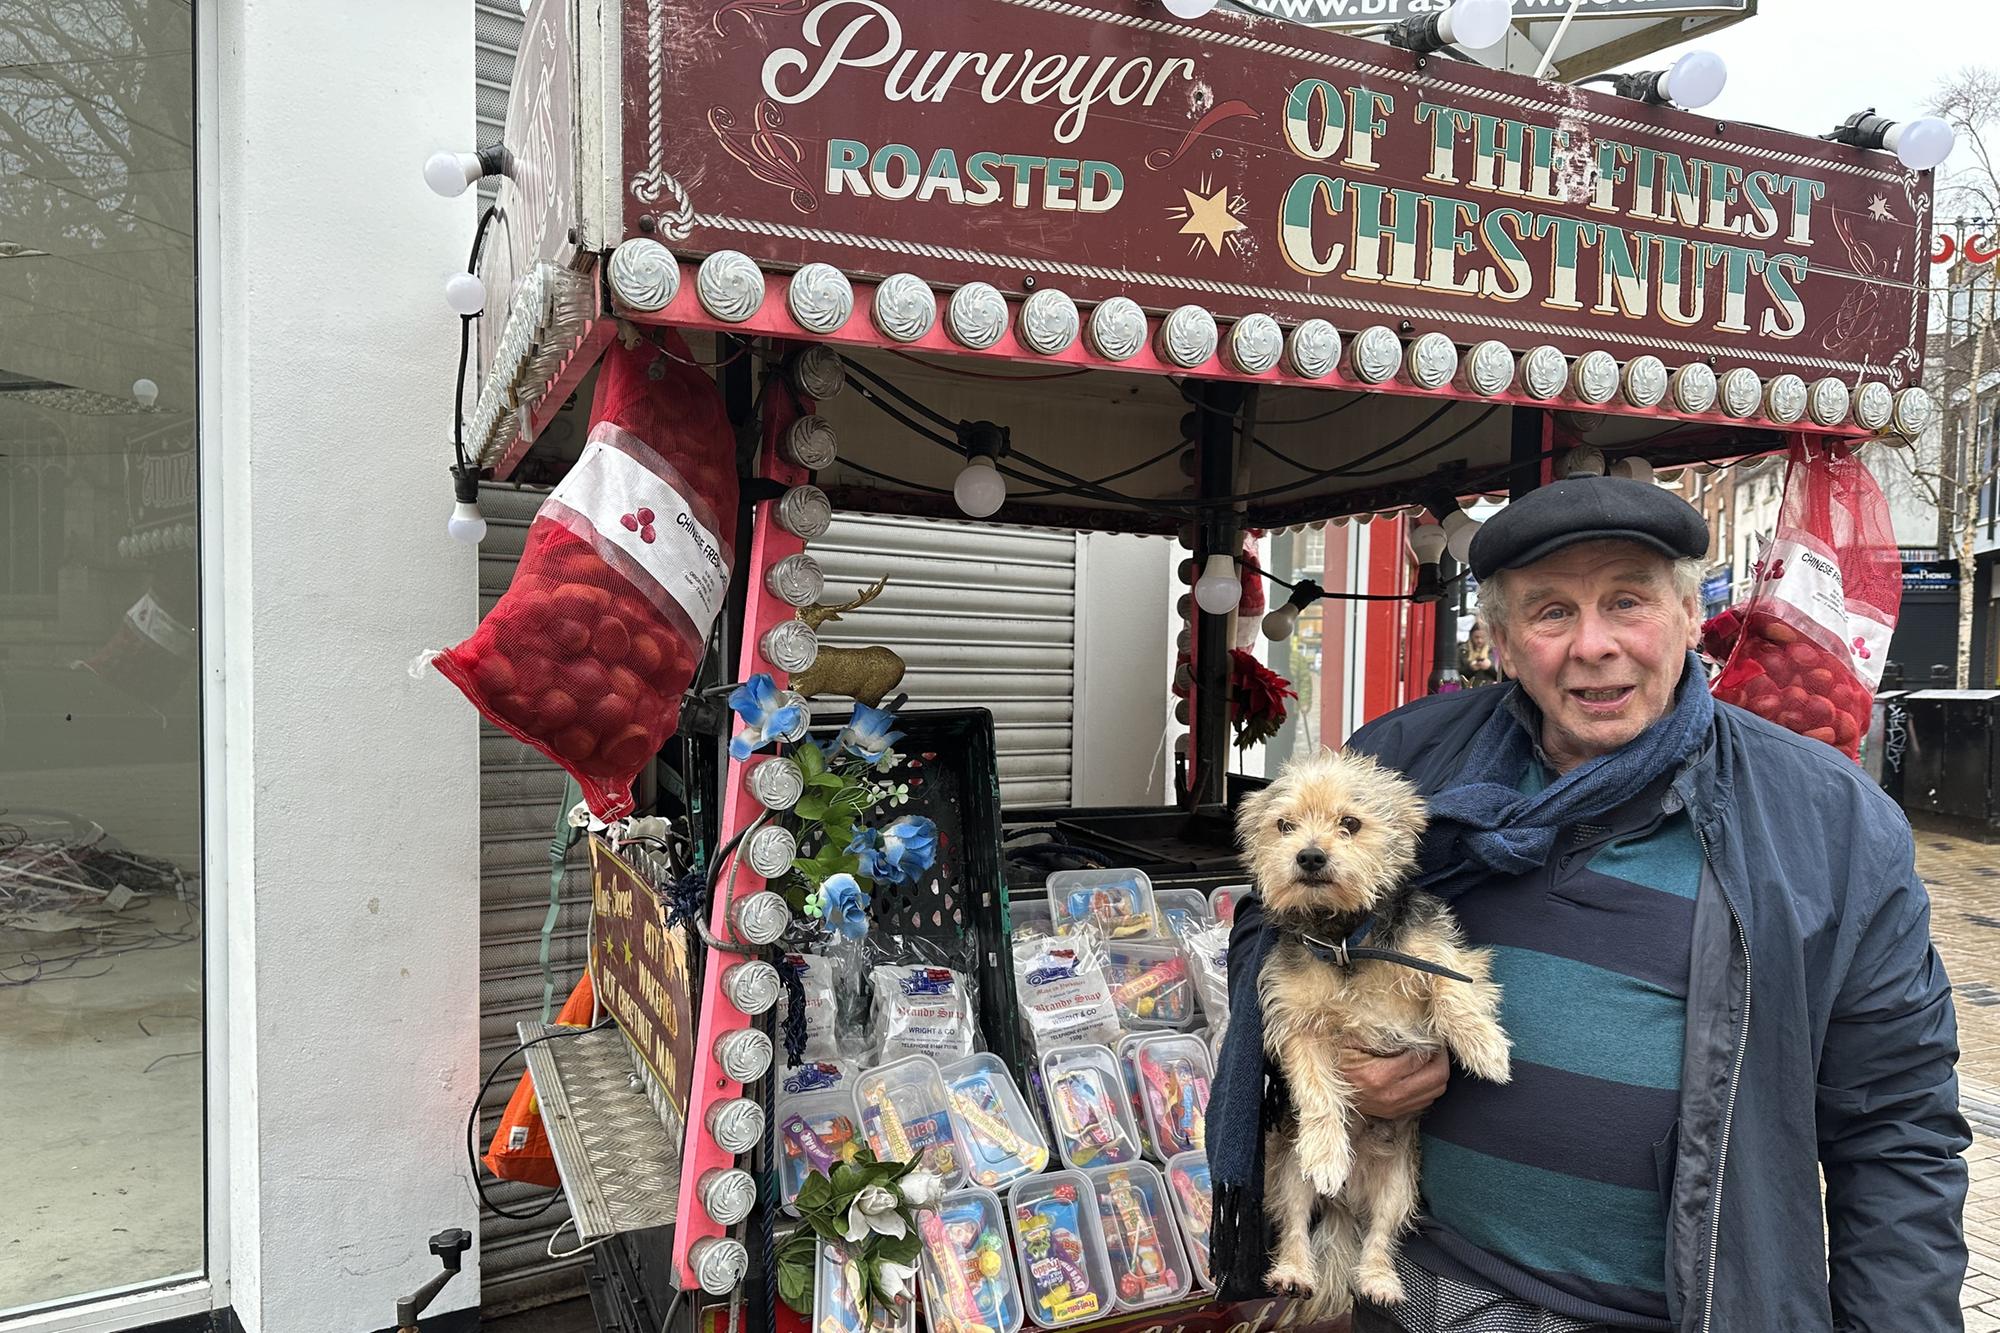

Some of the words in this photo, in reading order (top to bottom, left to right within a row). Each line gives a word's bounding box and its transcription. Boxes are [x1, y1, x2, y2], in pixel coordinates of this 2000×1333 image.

[762, 0, 1194, 144] Purveyor
[825, 138, 1124, 213] ROASTED
[1283, 78, 1394, 170] OF
[1414, 102, 1569, 204] THE
[1586, 138, 1826, 246] FINEST
[1278, 173, 1809, 340] CHESTNUTS
[676, 512, 705, 550] CHINESE
[1801, 552, 1834, 576] CHINESE
[639, 959, 678, 1041] WAKEFIELD
[1033, 998, 1072, 1013] Brandy
[1087, 1008, 1097, 1017] CO
[603, 965, 616, 1006] HOT
[618, 984, 653, 1054] CHESTNUT
[656, 1033, 676, 1095] MAN
[908, 1027, 936, 1035] WRIGHT
[903, 1118, 938, 1140] RIBO
